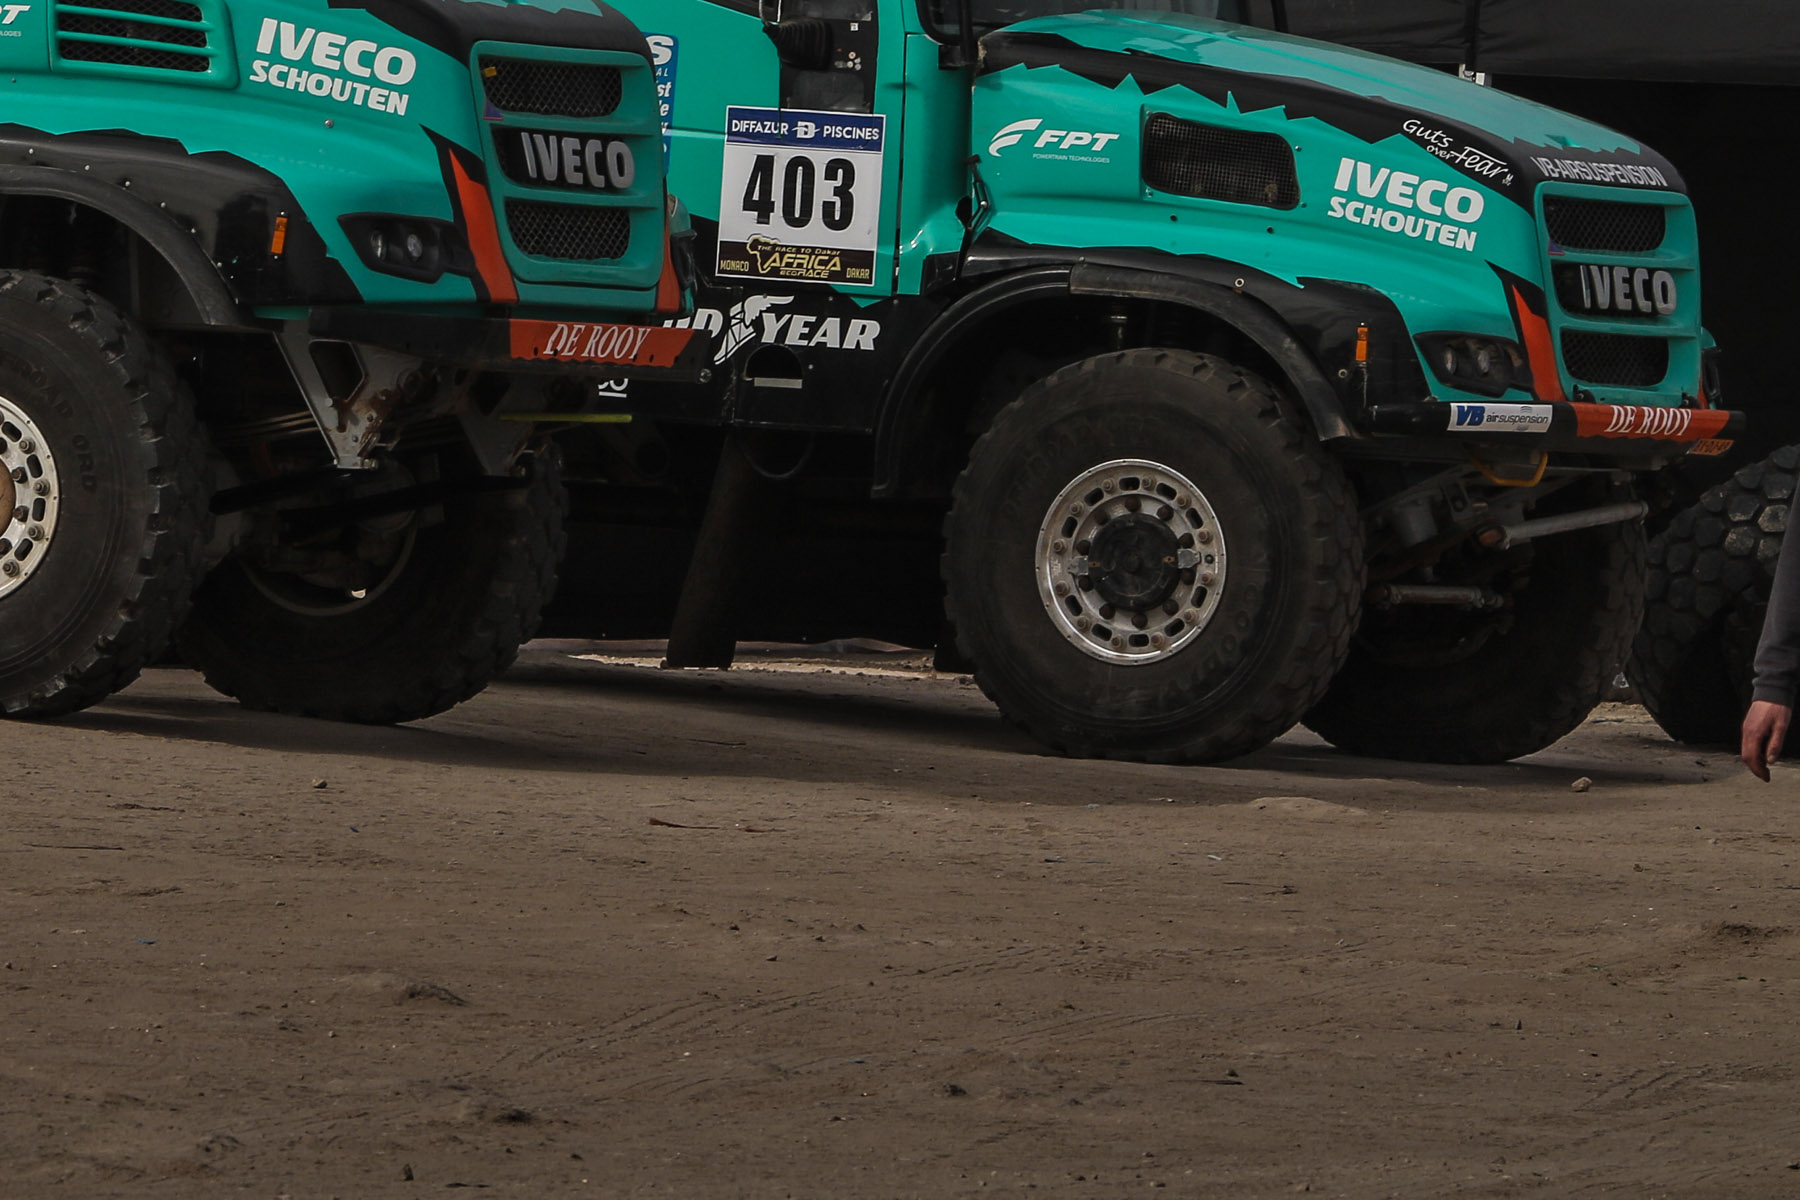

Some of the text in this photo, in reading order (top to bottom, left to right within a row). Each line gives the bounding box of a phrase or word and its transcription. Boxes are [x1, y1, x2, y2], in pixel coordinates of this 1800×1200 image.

[256, 18, 417, 86] IVECO
[250, 59, 409, 116] SCHOUTEN
[732, 119, 879, 140] DIFFAZUR PISCINES
[1034, 129, 1120, 151] FPT
[1403, 119, 1454, 148] Guts
[521, 131, 635, 189] IVECO
[1426, 144, 1509, 178] over Fear
[1530, 156, 1668, 187] VB-AIRSUSPENSION
[742, 154, 856, 231] 403
[1334, 157, 1485, 224] IVECO
[1328, 196, 1478, 252] SCHOUTEN
[720, 259, 749, 272] MONACO
[763, 252, 842, 271] AFRICA
[846, 267, 869, 279] DAKAR
[1579, 264, 1677, 316] IVECO
[544, 323, 653, 360] DE ROOY
[1456, 405, 1549, 426] VB airsuspension
[1605, 405, 1692, 437] DE ROOY
